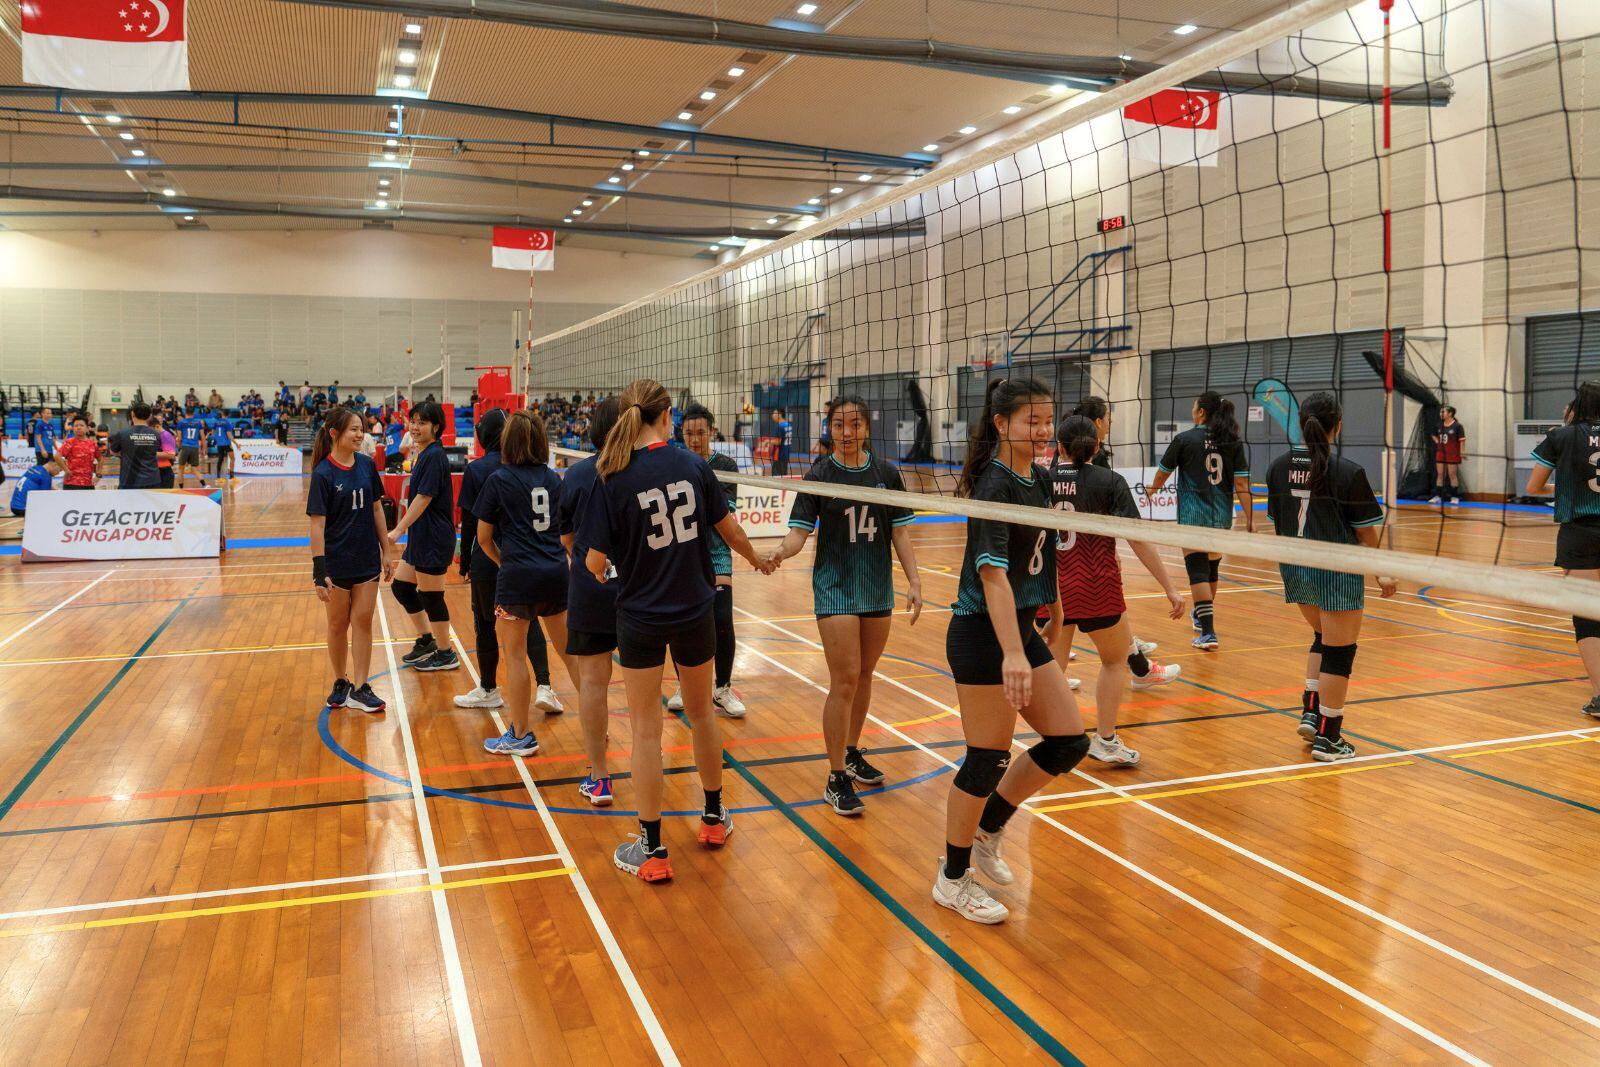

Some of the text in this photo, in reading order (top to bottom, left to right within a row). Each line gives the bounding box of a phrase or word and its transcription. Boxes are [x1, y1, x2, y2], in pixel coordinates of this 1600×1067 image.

[187, 428, 197, 440] 17
[242, 452, 289, 461] ETACTIVE!
[242, 460, 285, 468] SINGAPORE
[1205, 452, 1223, 486] 9
[352, 487, 364, 510] 11
[1052, 481, 1077, 495] MHA
[531, 486, 551, 532] 9
[1138, 496, 1178, 508] SINGA
[1290, 488, 1311, 537] 7
[637, 479, 699, 551] 32
[844, 505, 878, 543] 14
[60, 527, 175, 544] SINGAPORE
[1028, 529, 1047, 576] 8
